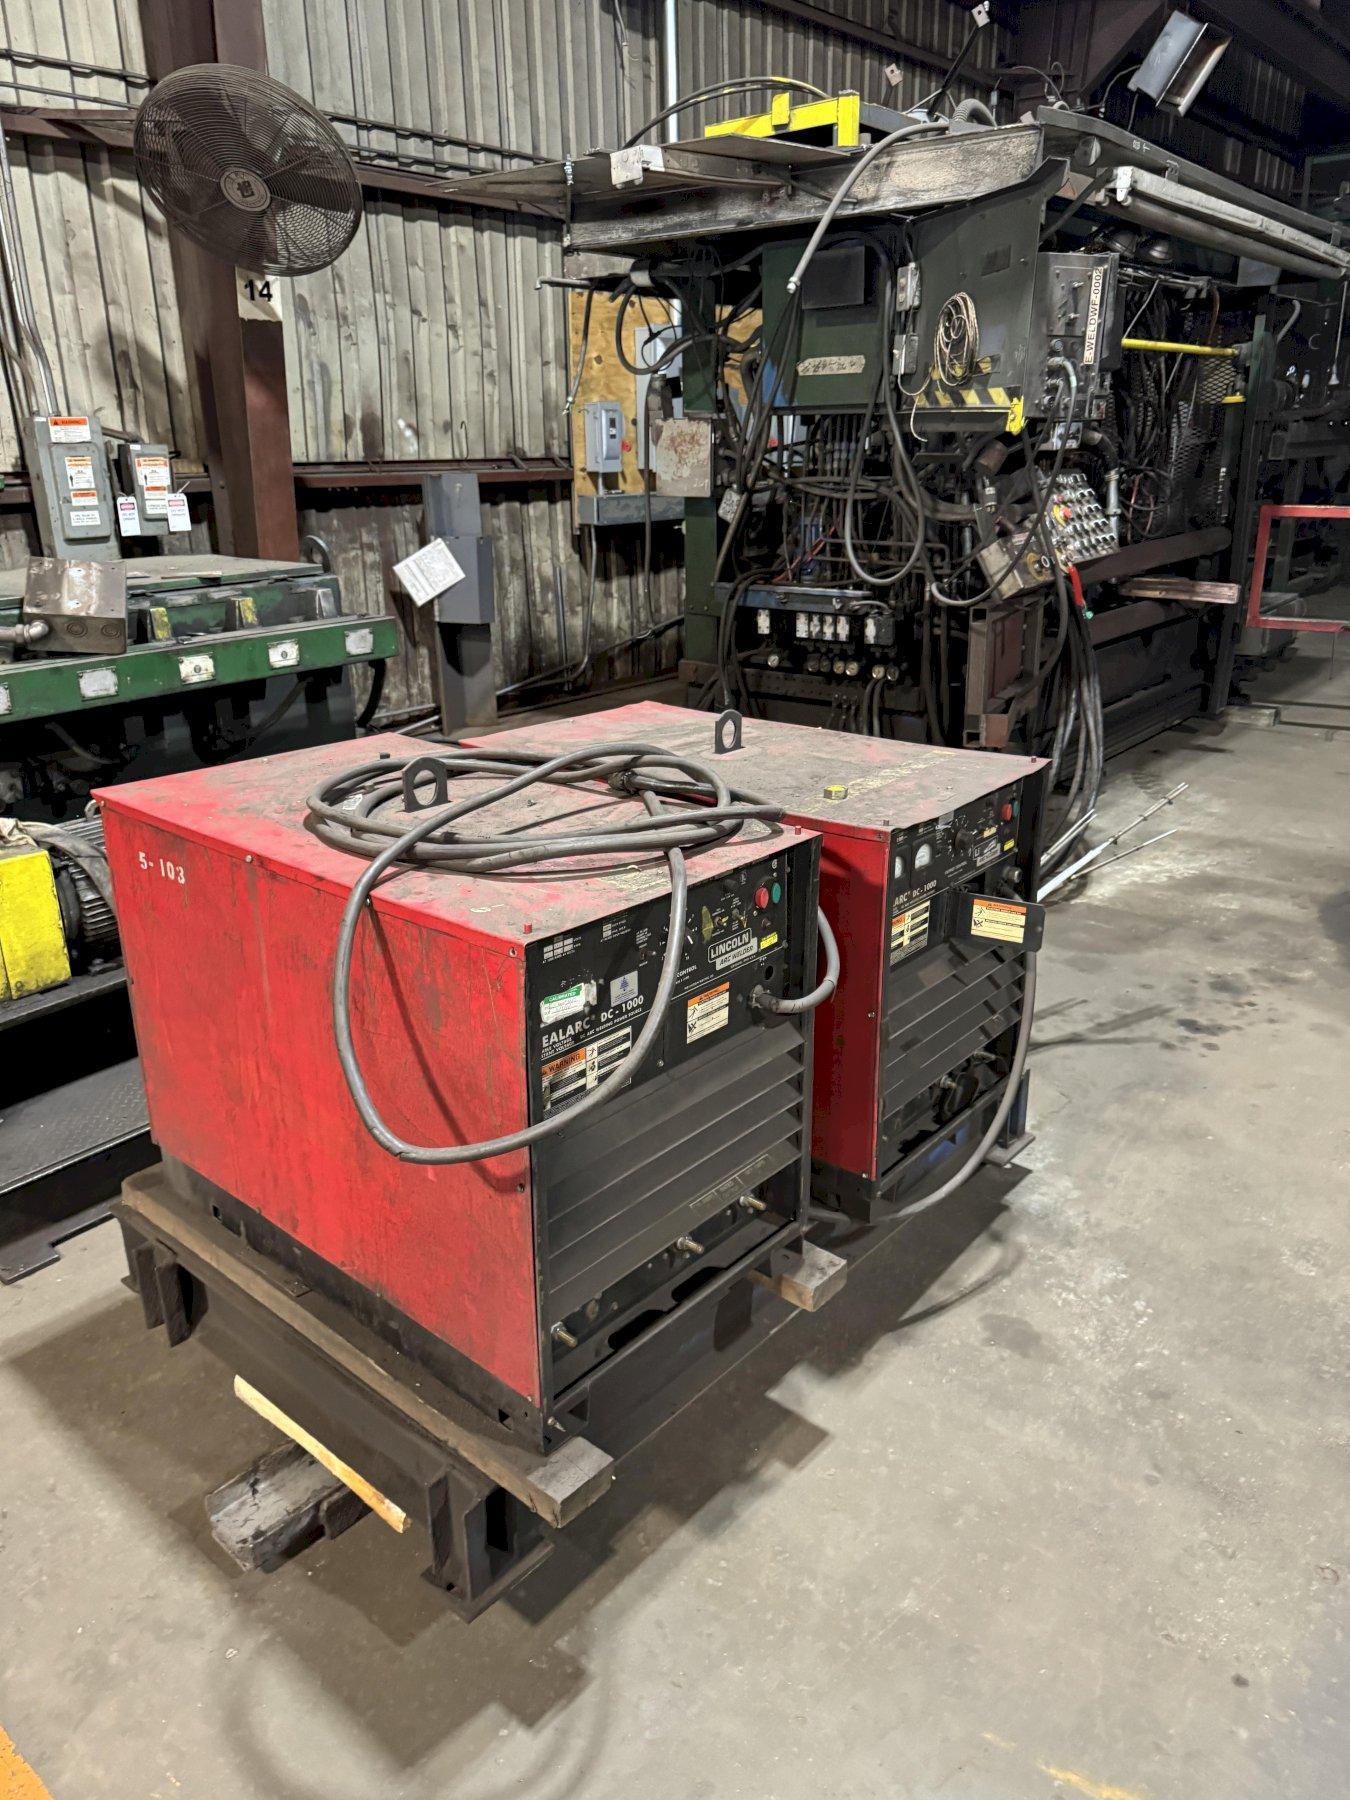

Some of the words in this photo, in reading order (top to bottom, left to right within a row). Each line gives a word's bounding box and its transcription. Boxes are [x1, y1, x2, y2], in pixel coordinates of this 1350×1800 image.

[244, 279, 273, 302] 14
[138, 851, 186, 885] 5-103
[710, 931, 750, 959] LINCOLN
[719, 954, 732, 966] ARC
[600, 1008, 614, 1022] DC
[621, 995, 644, 1013] 1000
[549, 1053, 580, 1072] WARNING
